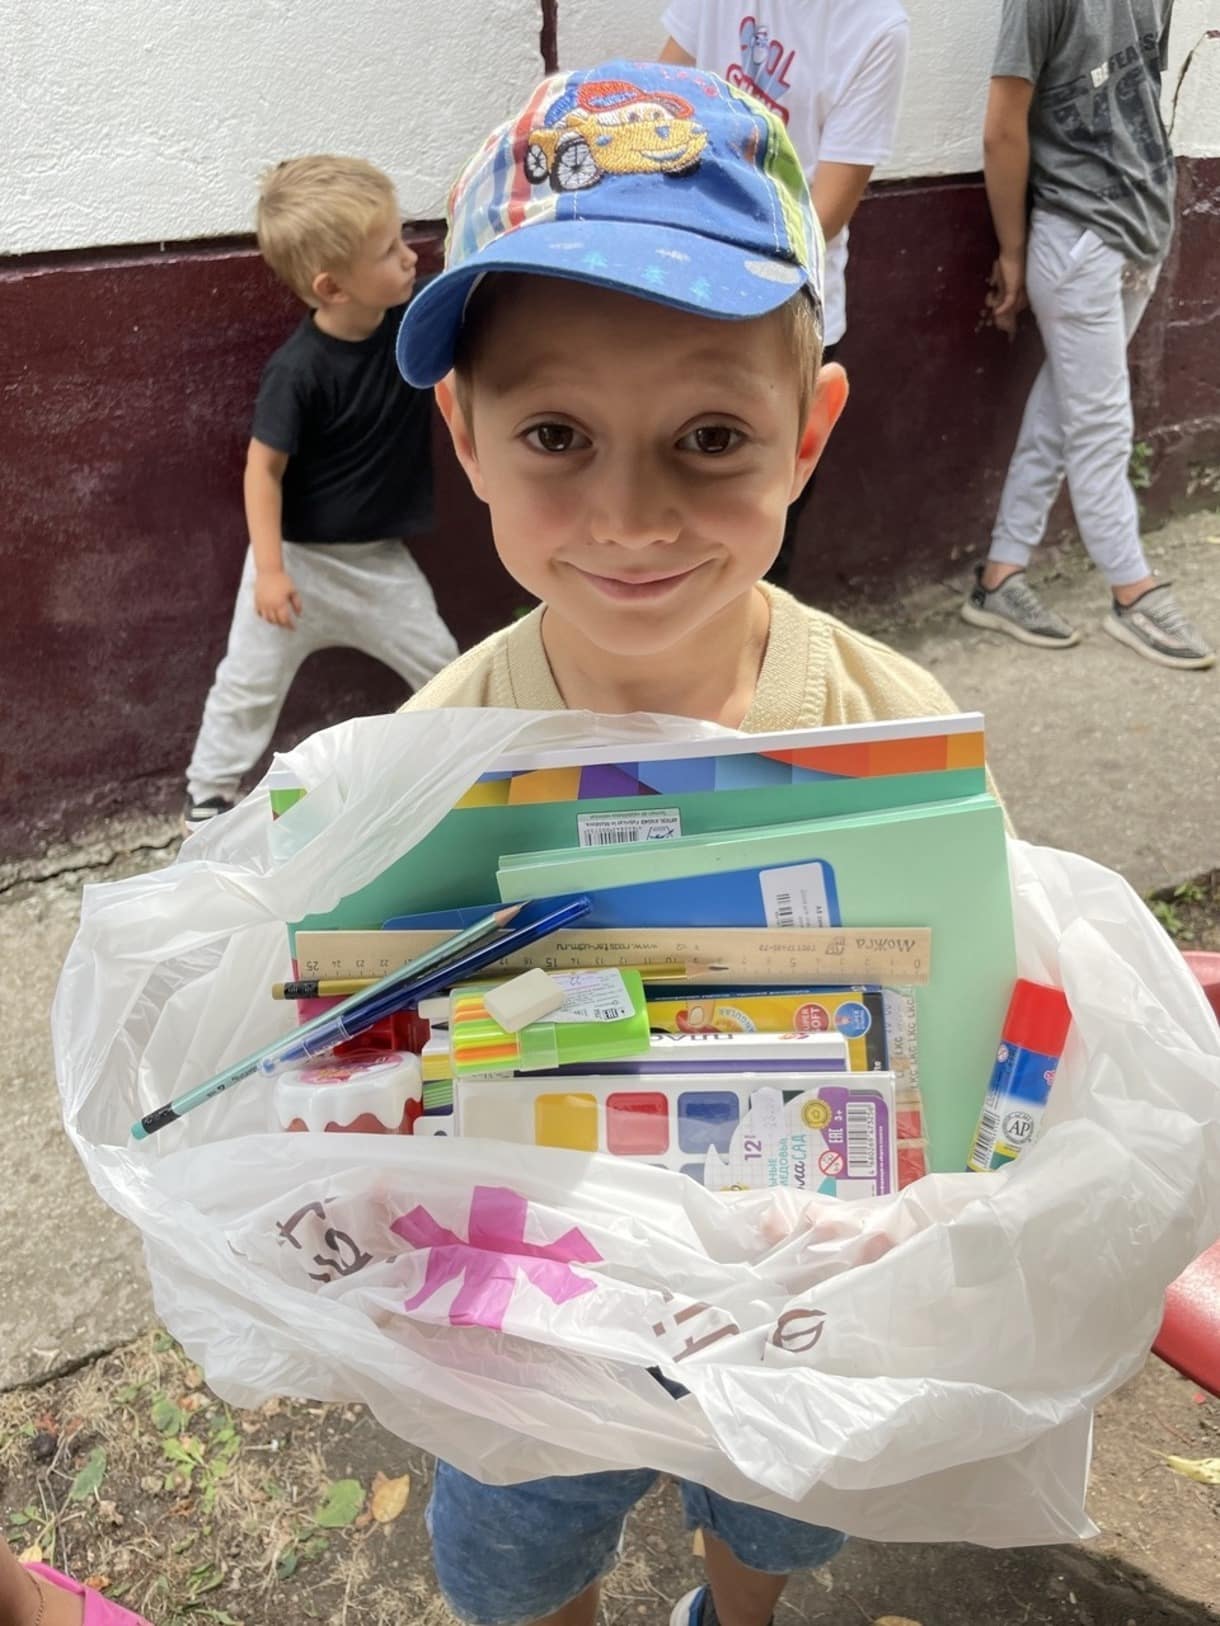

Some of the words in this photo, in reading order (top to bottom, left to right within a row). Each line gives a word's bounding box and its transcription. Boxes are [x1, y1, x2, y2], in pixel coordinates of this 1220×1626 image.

[855, 937, 916, 953] Можга
[306, 960, 320, 972] 25
[545, 956, 558, 968] 15
[1008, 1119, 1031, 1137] AP
[744, 1139, 762, 1161] 12
